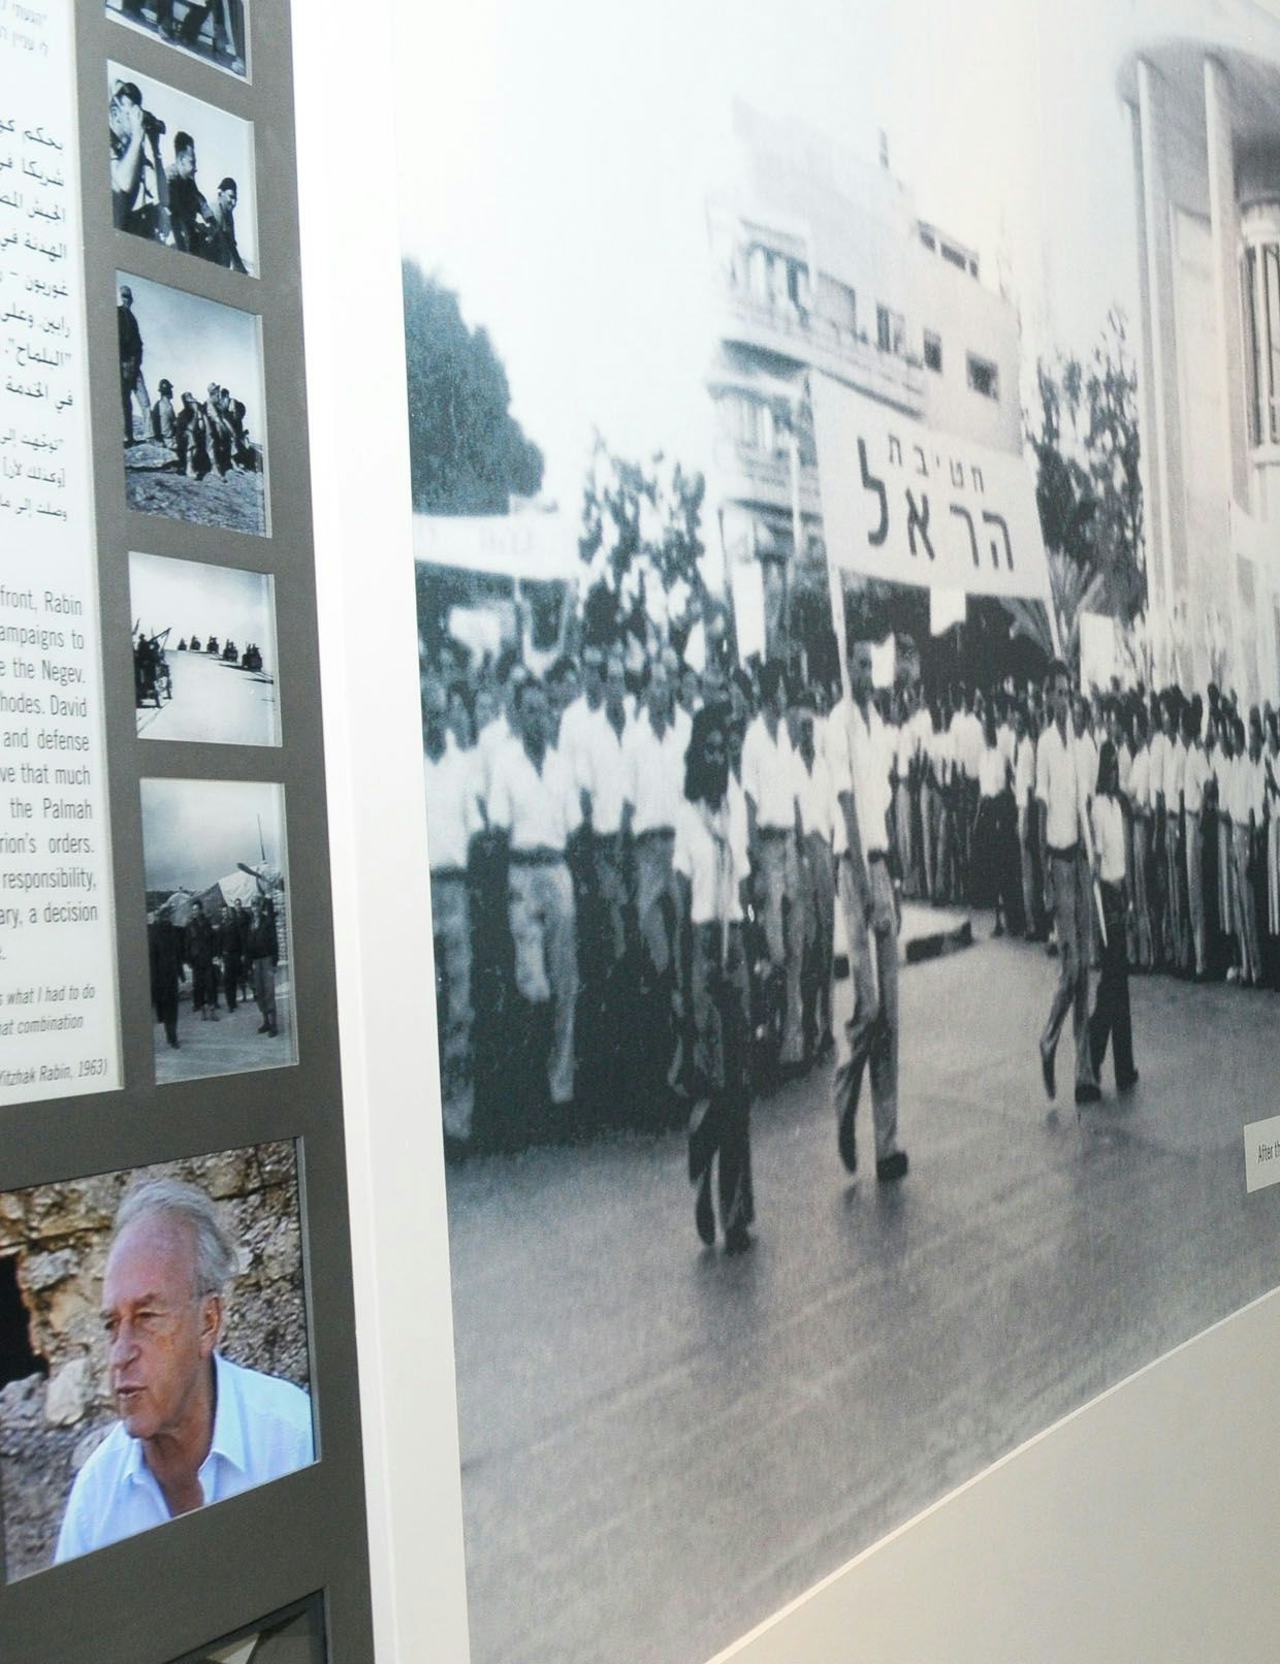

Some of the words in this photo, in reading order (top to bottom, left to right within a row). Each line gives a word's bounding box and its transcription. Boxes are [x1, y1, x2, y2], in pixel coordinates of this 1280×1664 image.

[24, 127, 63, 155] بحكم
[28, 199, 66, 225] الجيش
[5, 376, 49, 401] الخدمة
[55, 388, 74, 415] في
[886, 432, 985, 495] חטיבת
[856, 435, 1014, 572] הראל
[44, 591, 83, 616] Rabin
[0, 624, 65, 651] ampaigns
[72, 629, 85, 650] to
[13, 657, 35, 679] the
[42, 659, 86, 687] Negev.
[0, 691, 46, 715] hodes.
[50, 694, 87, 718] David
[4, 728, 29, 748] and
[37, 728, 90, 751] defense
[21, 764, 49, 785] that
[55, 765, 91, 785] much
[10, 798, 32, 819] the
[43, 797, 93, 820] Palmah
[48, 833, 95, 854] orders.
[3, 866, 97, 893] responsibility,
[29, 908, 37, 924] a
[43, 901, 98, 923] decision
[7, 988, 34, 1005] what
[45, 985, 66, 1002] had
[69, 985, 79, 1000] to
[82, 983, 96, 1000] do
[17, 1013, 84, 1034] combination
[1257, 1142, 1273, 1163] After
